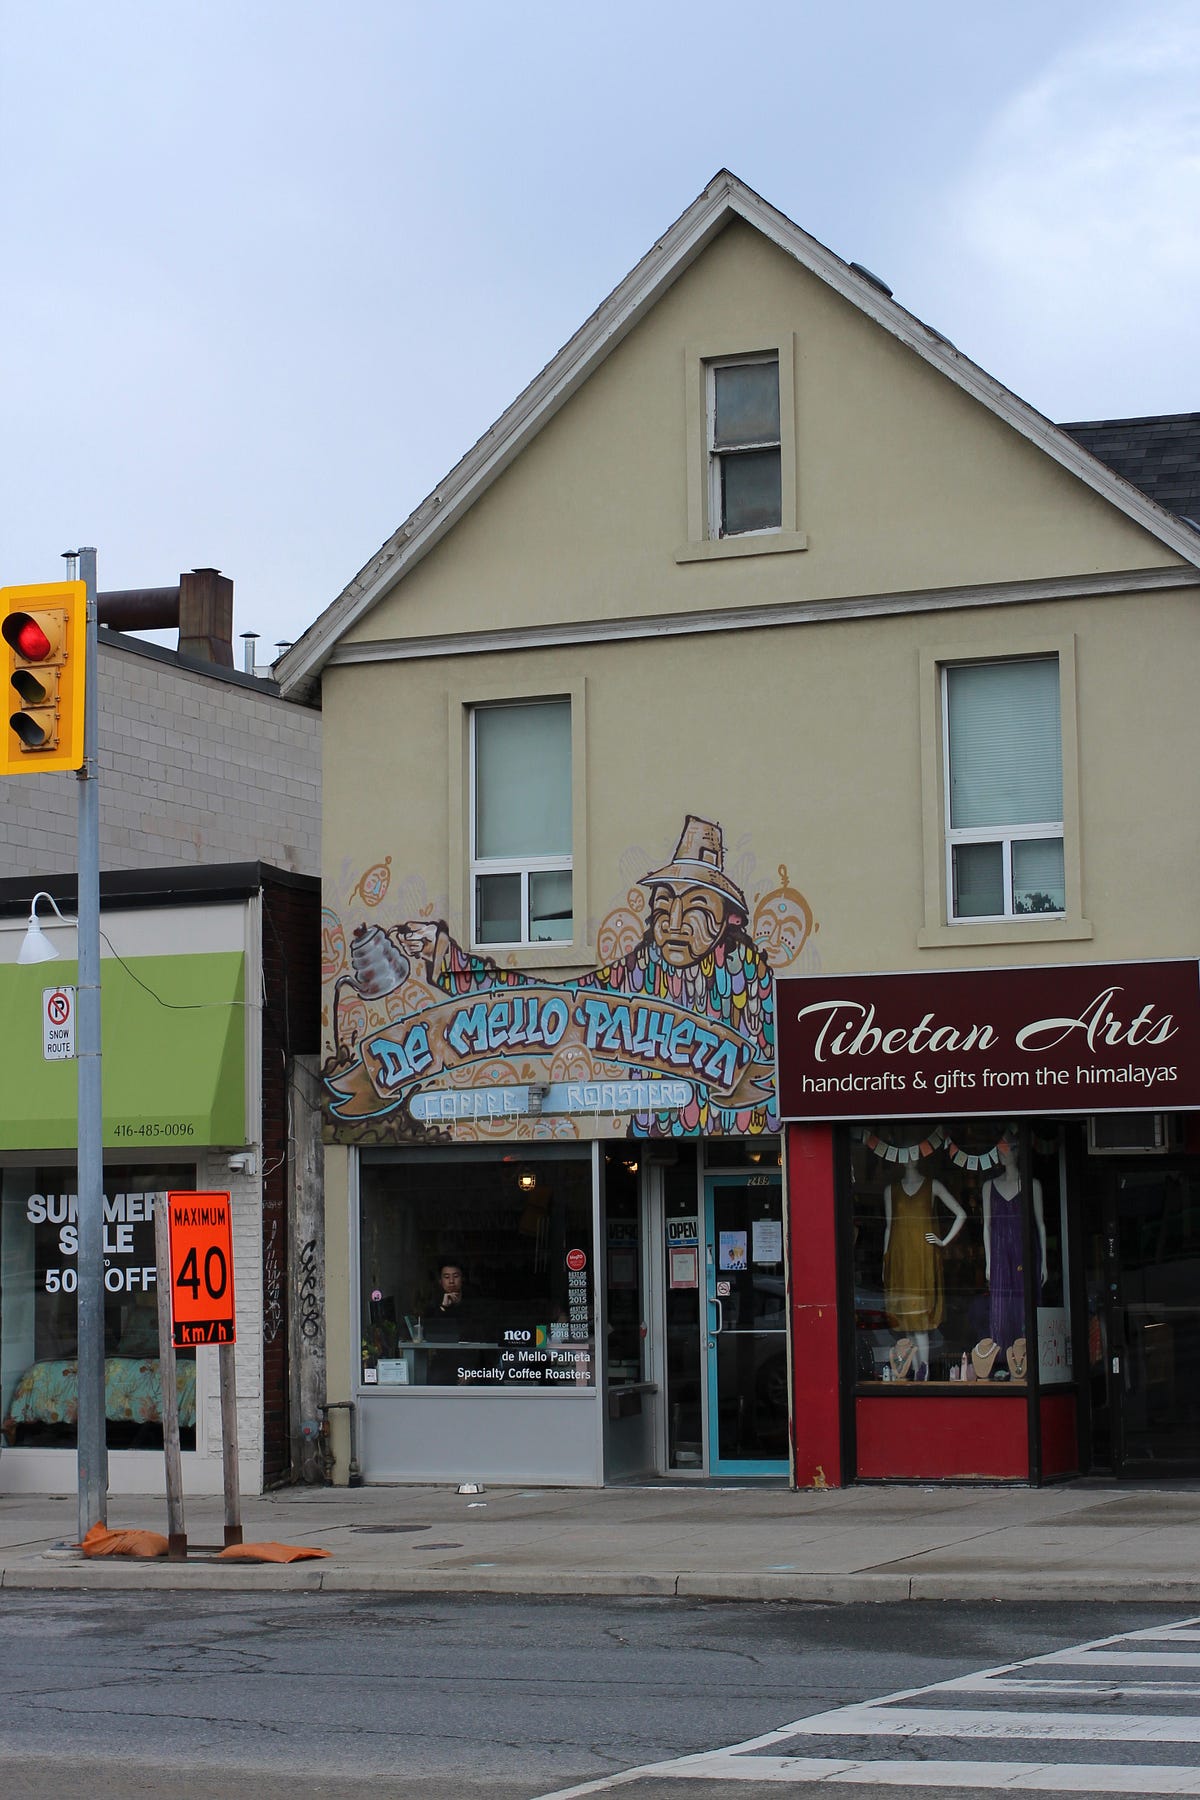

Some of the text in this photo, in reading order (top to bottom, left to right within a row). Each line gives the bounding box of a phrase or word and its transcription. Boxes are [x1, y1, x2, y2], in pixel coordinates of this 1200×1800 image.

[797, 986, 1179, 1062] Tibetan Arts
[49, 1029, 69, 1039] SNOW
[47, 1042, 70, 1053] ROUTE
[802, 1063, 1178, 1094] handcrafts & gifts from the himalayas
[113, 1122, 194, 1138] 416-485-0096
[174, 1207, 226, 1226] MAXIMUM
[58, 1224, 134, 1255] SLE
[669, 1222, 698, 1239] OPEN
[104, 1267, 157, 1293] OFF
[176, 1246, 227, 1300] 40
[181, 1322, 226, 1343] km/h
[503, 1330, 531, 1341] neo
[502, 1351, 591, 1362] de Mello Palheta
[457, 1367, 591, 1380] Specialty Coffee Roasters
